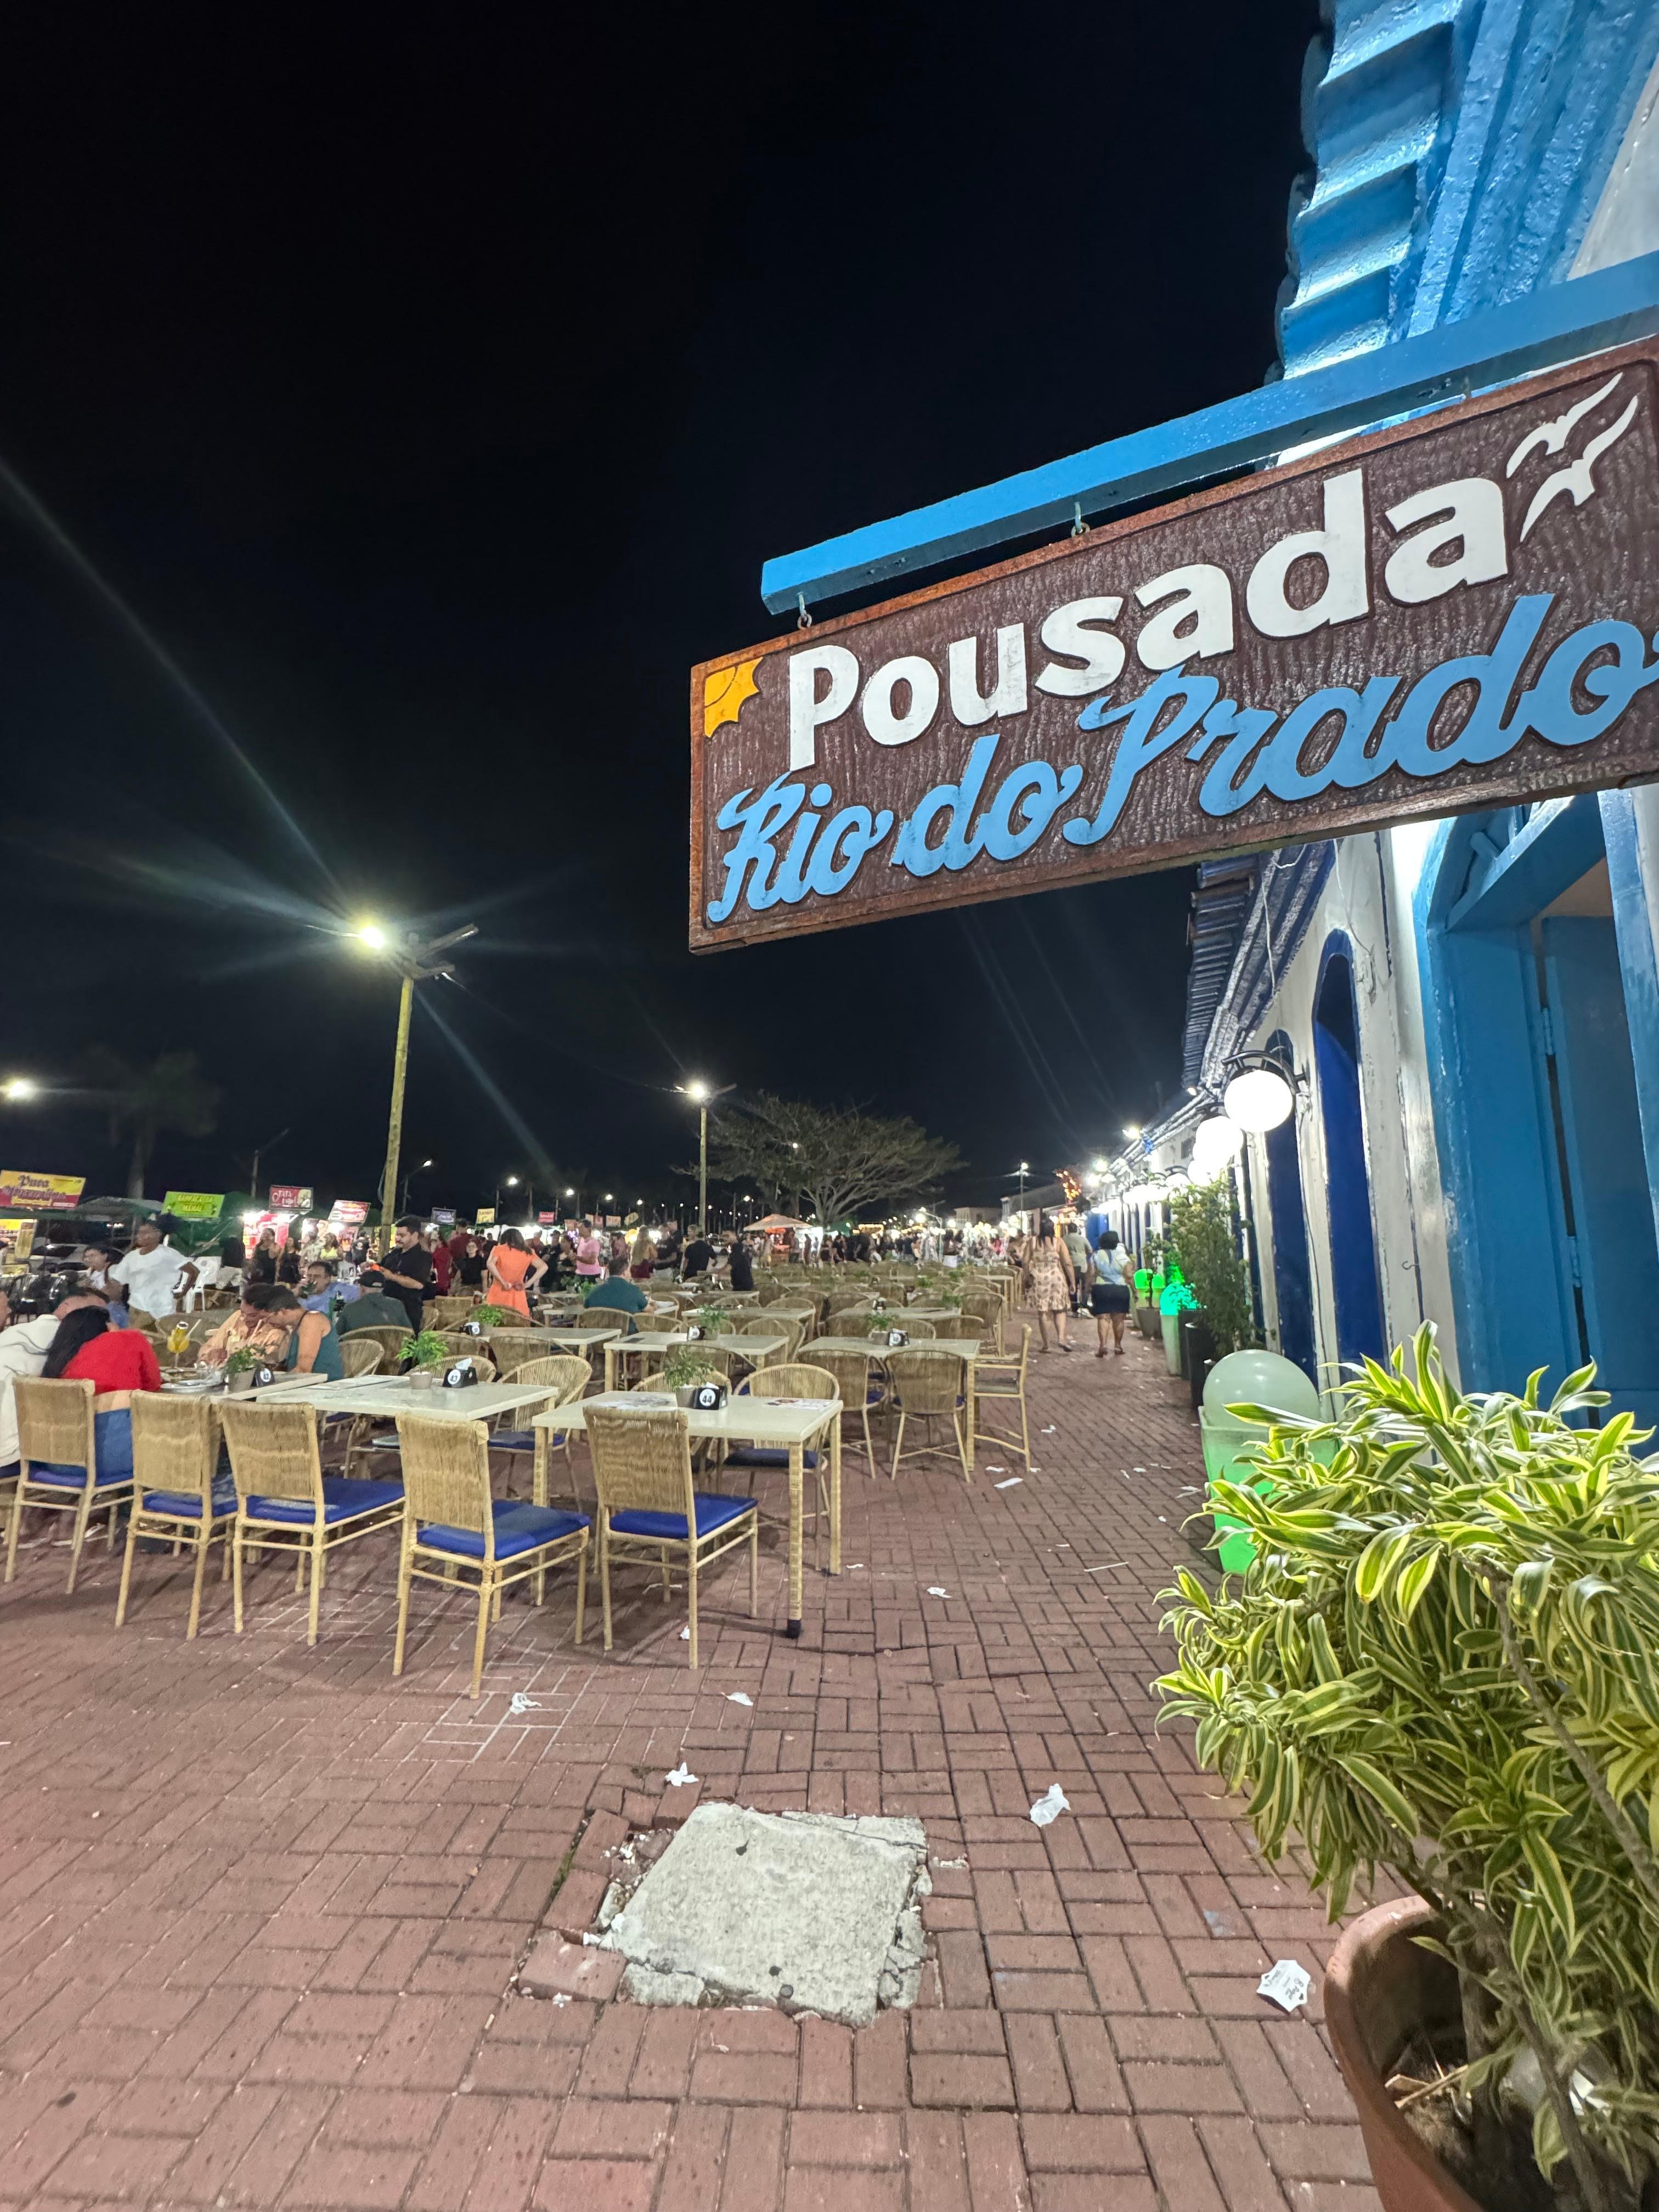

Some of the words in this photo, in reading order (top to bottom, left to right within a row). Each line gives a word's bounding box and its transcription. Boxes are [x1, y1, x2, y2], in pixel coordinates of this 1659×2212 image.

[708, 770, 894, 923] Rio
[891, 733, 1083, 877] do
[1063, 593, 1659, 845] Prado
[789, 469, 1508, 772] Pousada
[702, 1395, 712, 1403] 44
